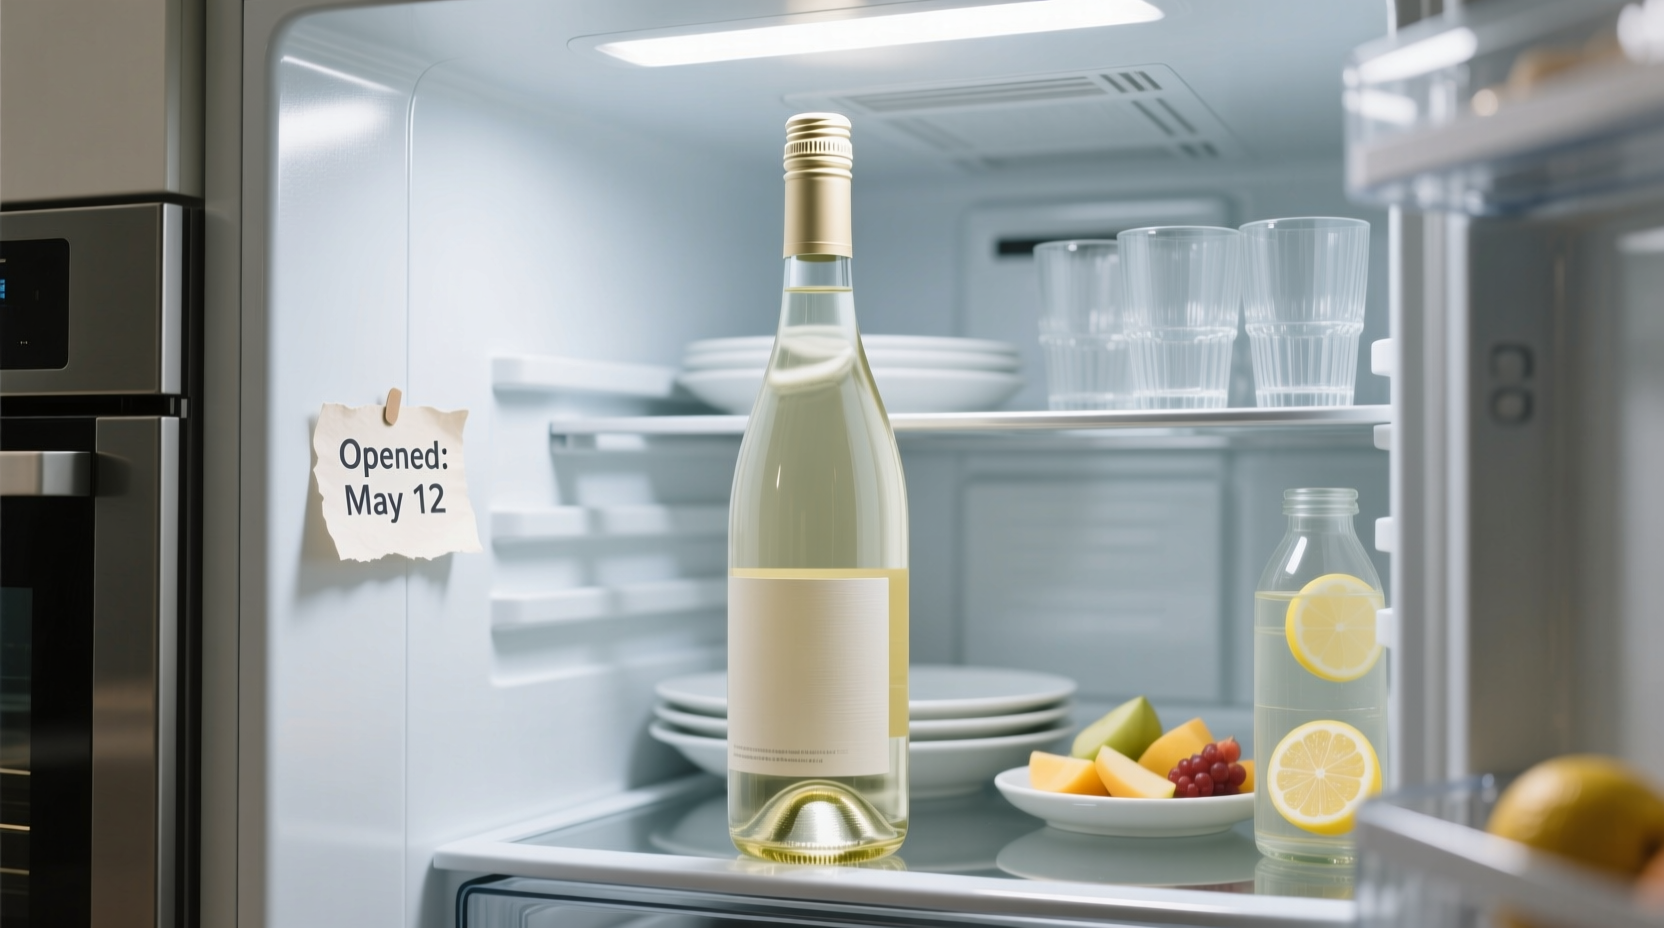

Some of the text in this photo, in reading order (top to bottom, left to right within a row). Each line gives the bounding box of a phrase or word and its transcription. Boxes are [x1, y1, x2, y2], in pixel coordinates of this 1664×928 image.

[339, 438, 448, 478] Opened:
[344, 483, 446, 524] May 12
